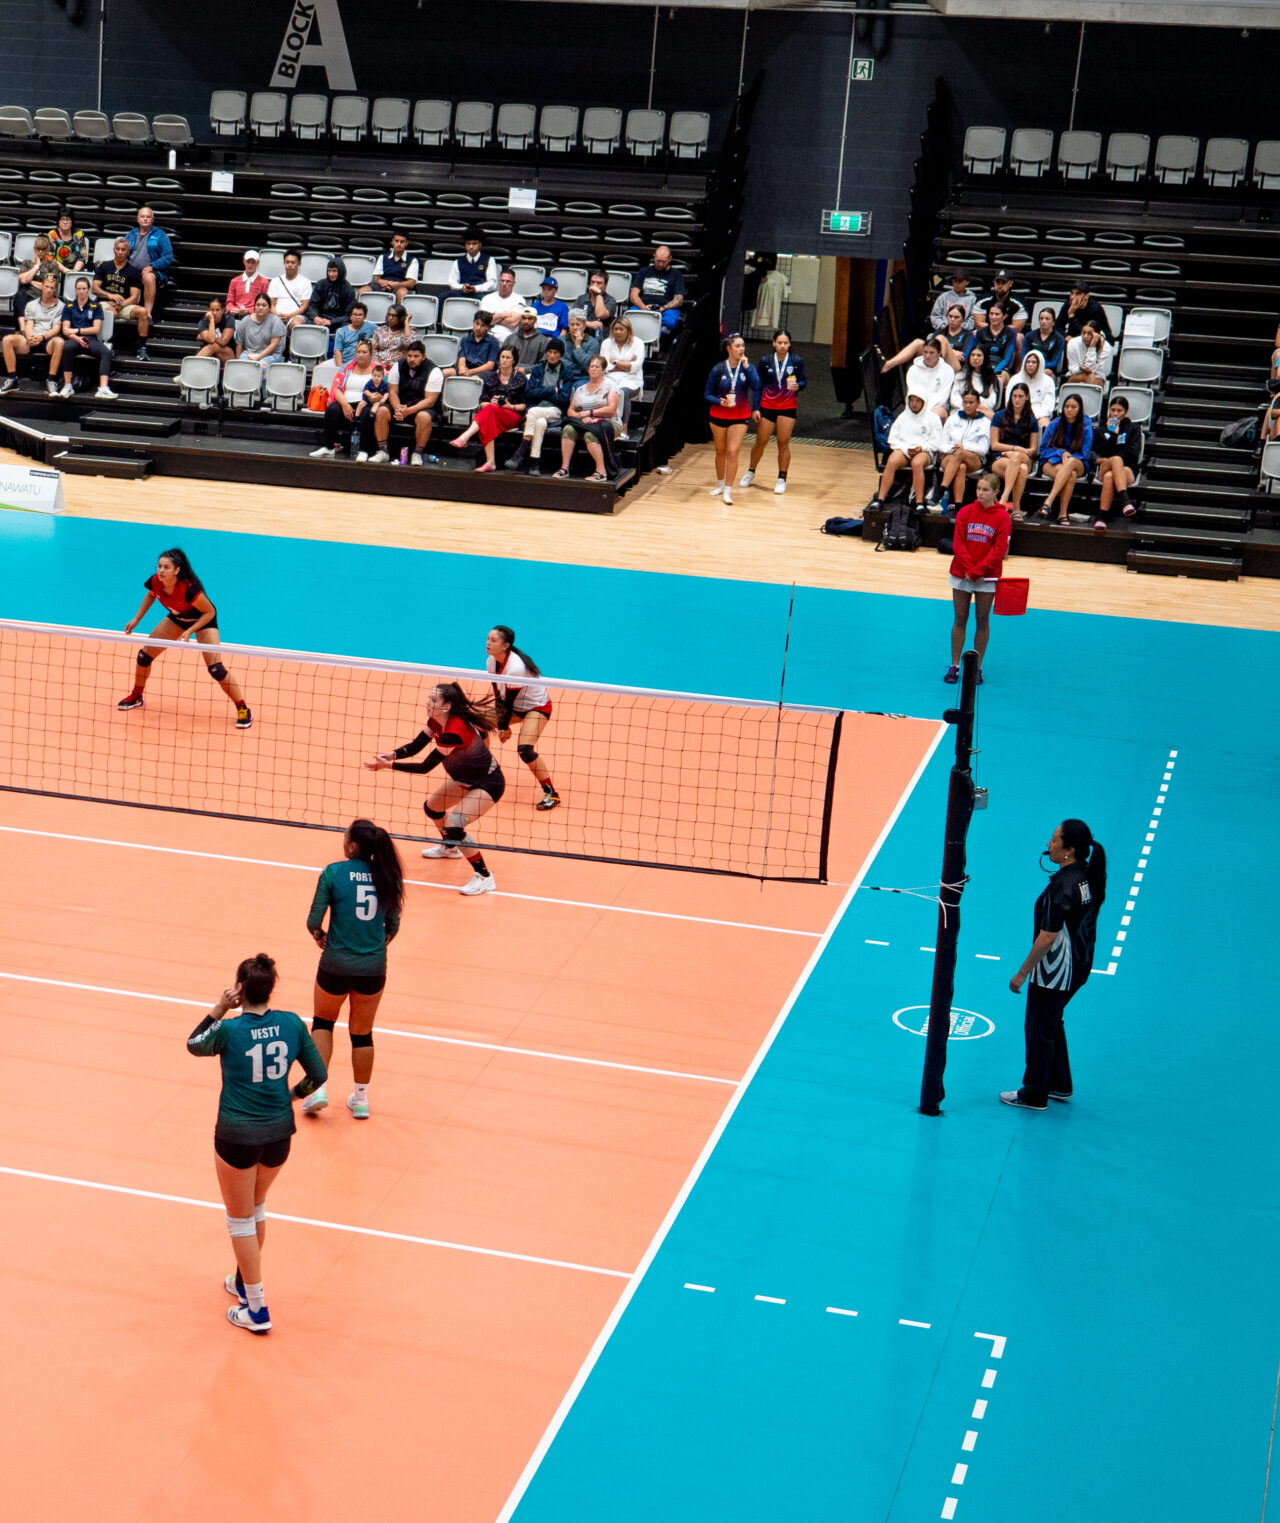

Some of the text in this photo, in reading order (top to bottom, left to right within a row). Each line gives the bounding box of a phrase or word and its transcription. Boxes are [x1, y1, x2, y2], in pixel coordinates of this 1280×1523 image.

[278, 2, 315, 79] BLOCK
[355, 885, 378, 921] 5
[250, 1025, 280, 1040] VESTY
[245, 1040, 288, 1083] 13
